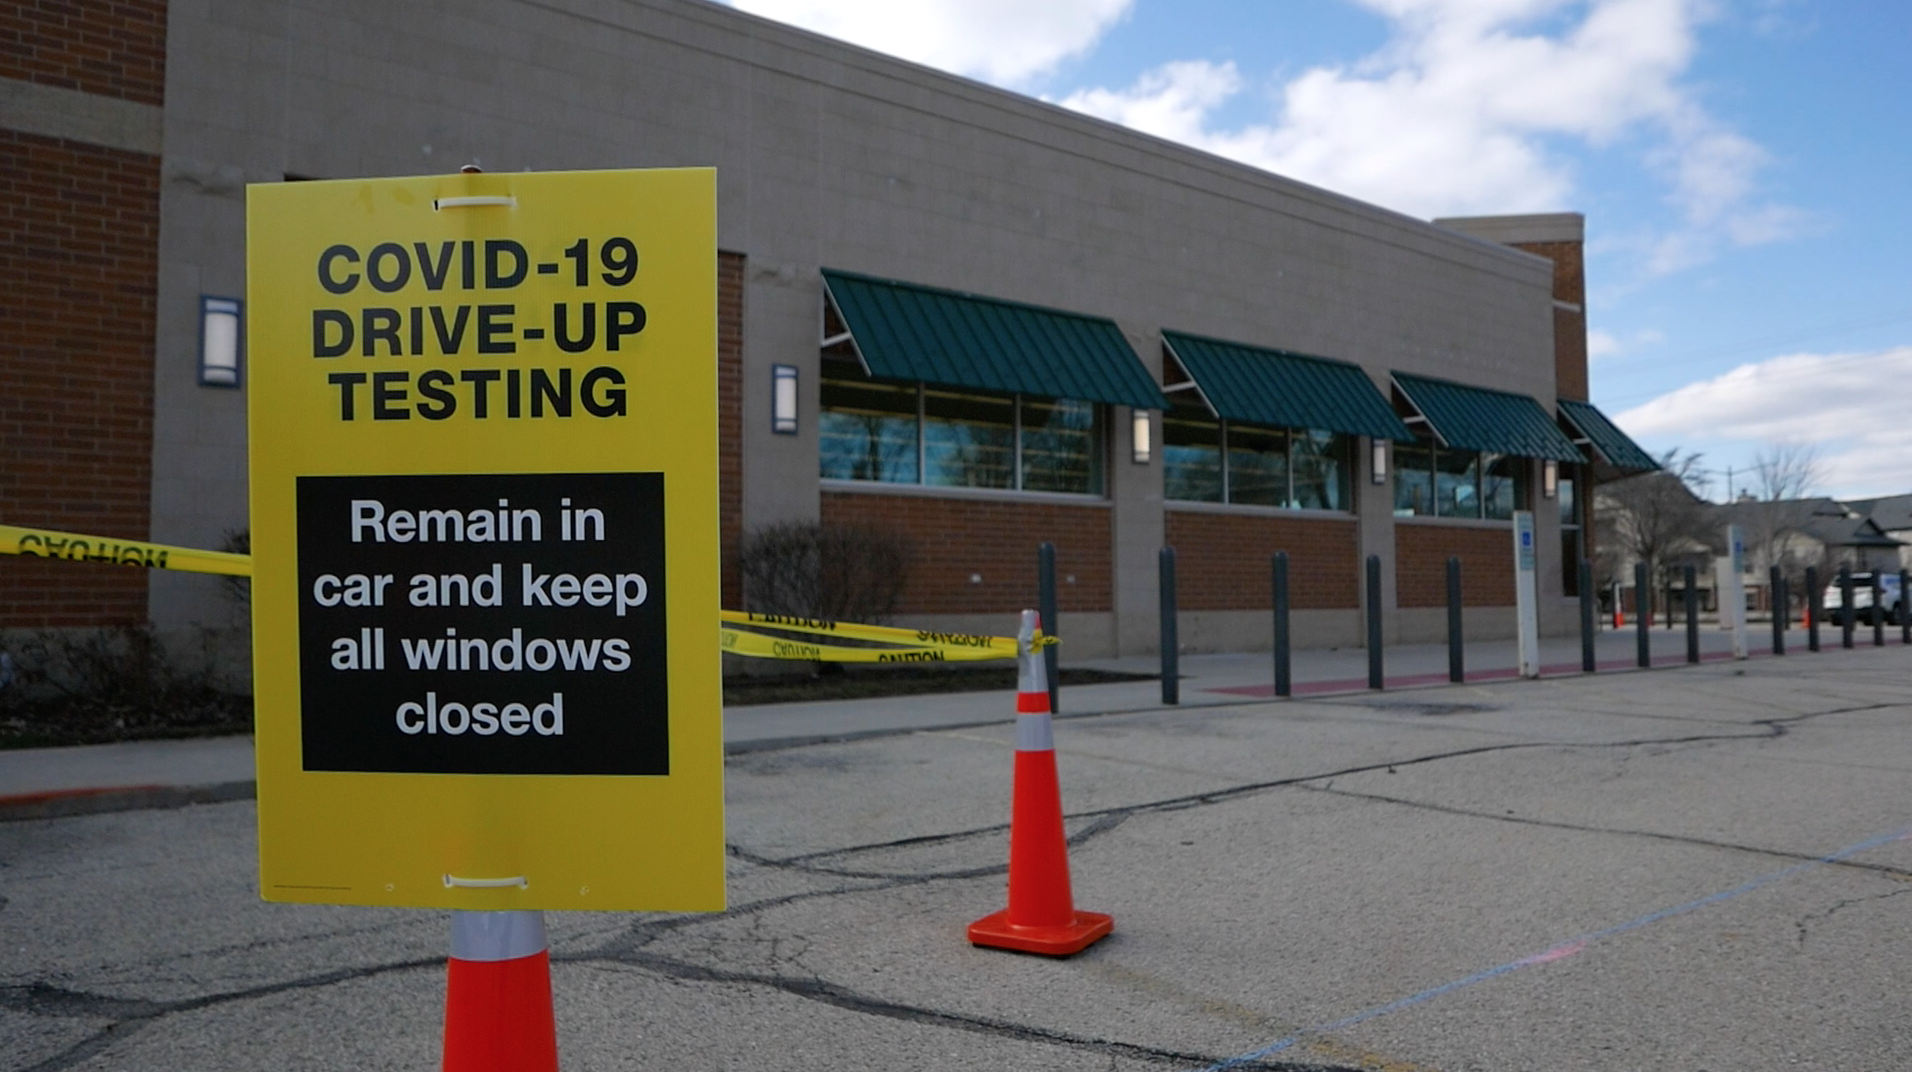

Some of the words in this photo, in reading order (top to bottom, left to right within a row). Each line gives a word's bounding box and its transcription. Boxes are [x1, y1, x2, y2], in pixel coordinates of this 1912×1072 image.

[317, 236, 640, 295] COVID-19
[312, 301, 647, 359] DRIVE-UP
[327, 365, 628, 422] TESTING
[351, 498, 542, 543] Remain
[561, 497, 605, 541] in
[313, 574, 394, 607] car
[409, 563, 502, 607] and
[522, 563, 648, 616] keep
[331, 627, 385, 670] all
[401, 627, 631, 671] windows
[396, 691, 564, 736] closed
